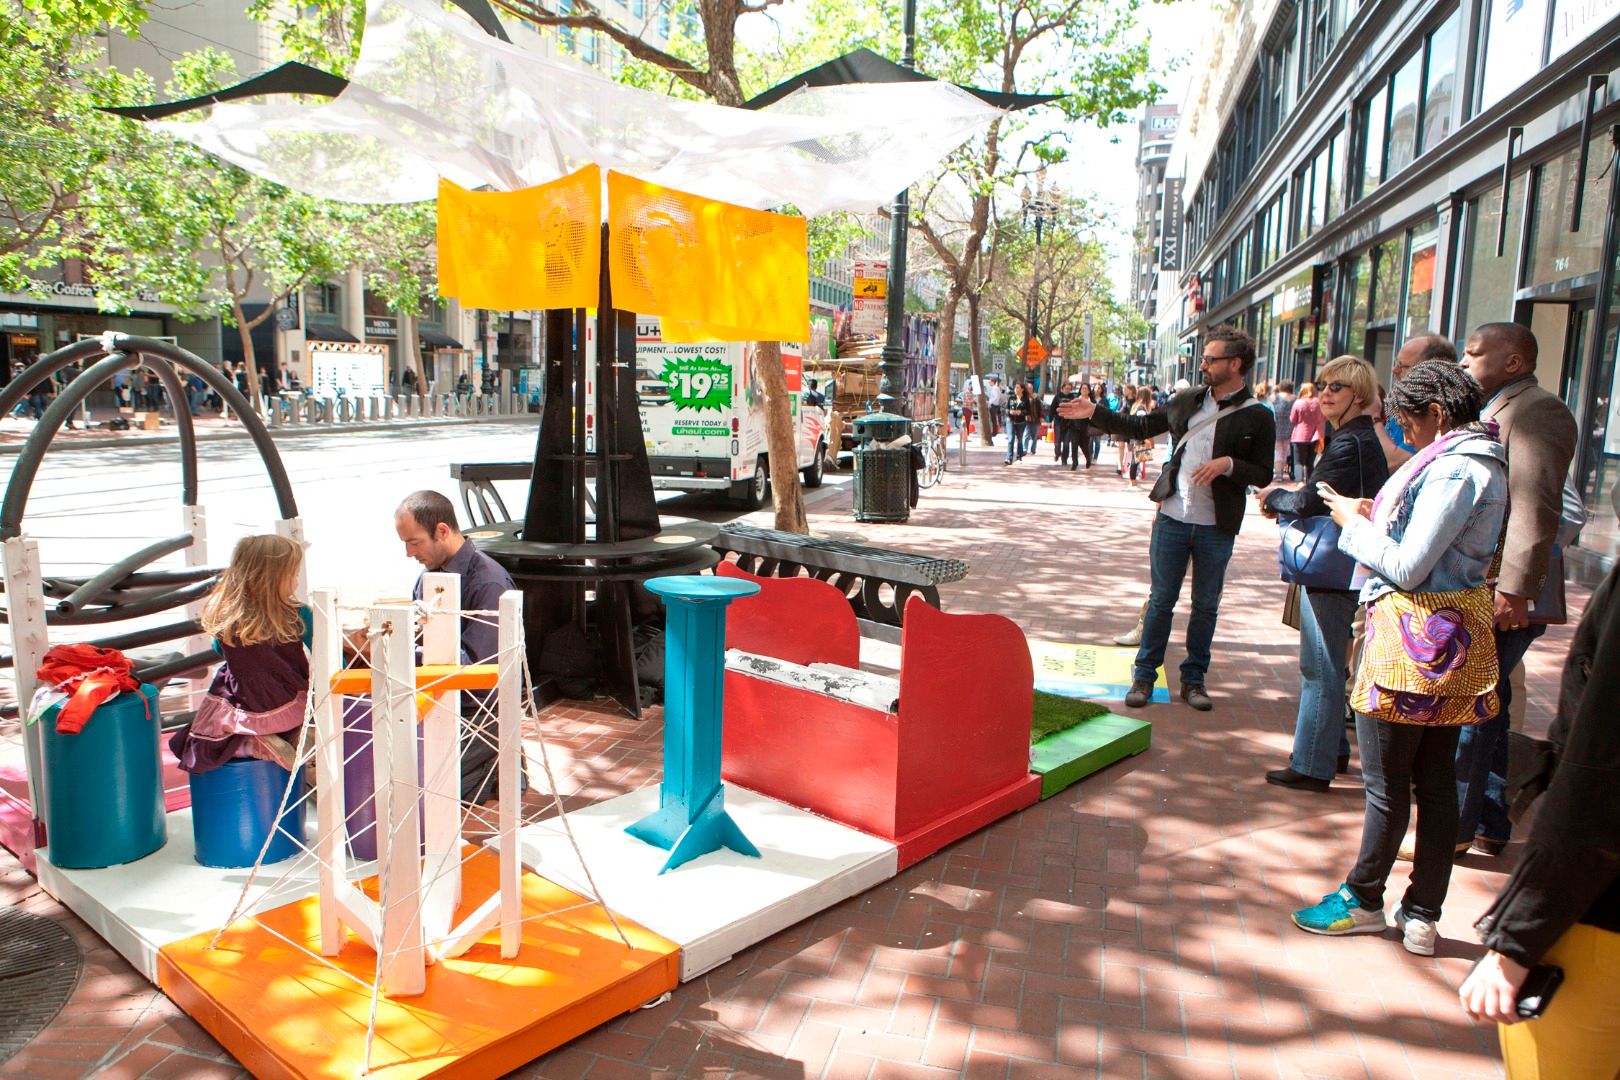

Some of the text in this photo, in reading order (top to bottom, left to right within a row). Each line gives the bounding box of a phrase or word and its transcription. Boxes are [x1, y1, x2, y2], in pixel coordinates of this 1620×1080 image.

[1164, 181, 1180, 268] XXI FOREVER
[54, 281, 93, 297] Coffee
[855, 301, 864, 311] NO
[704, 346, 726, 354] COST!
